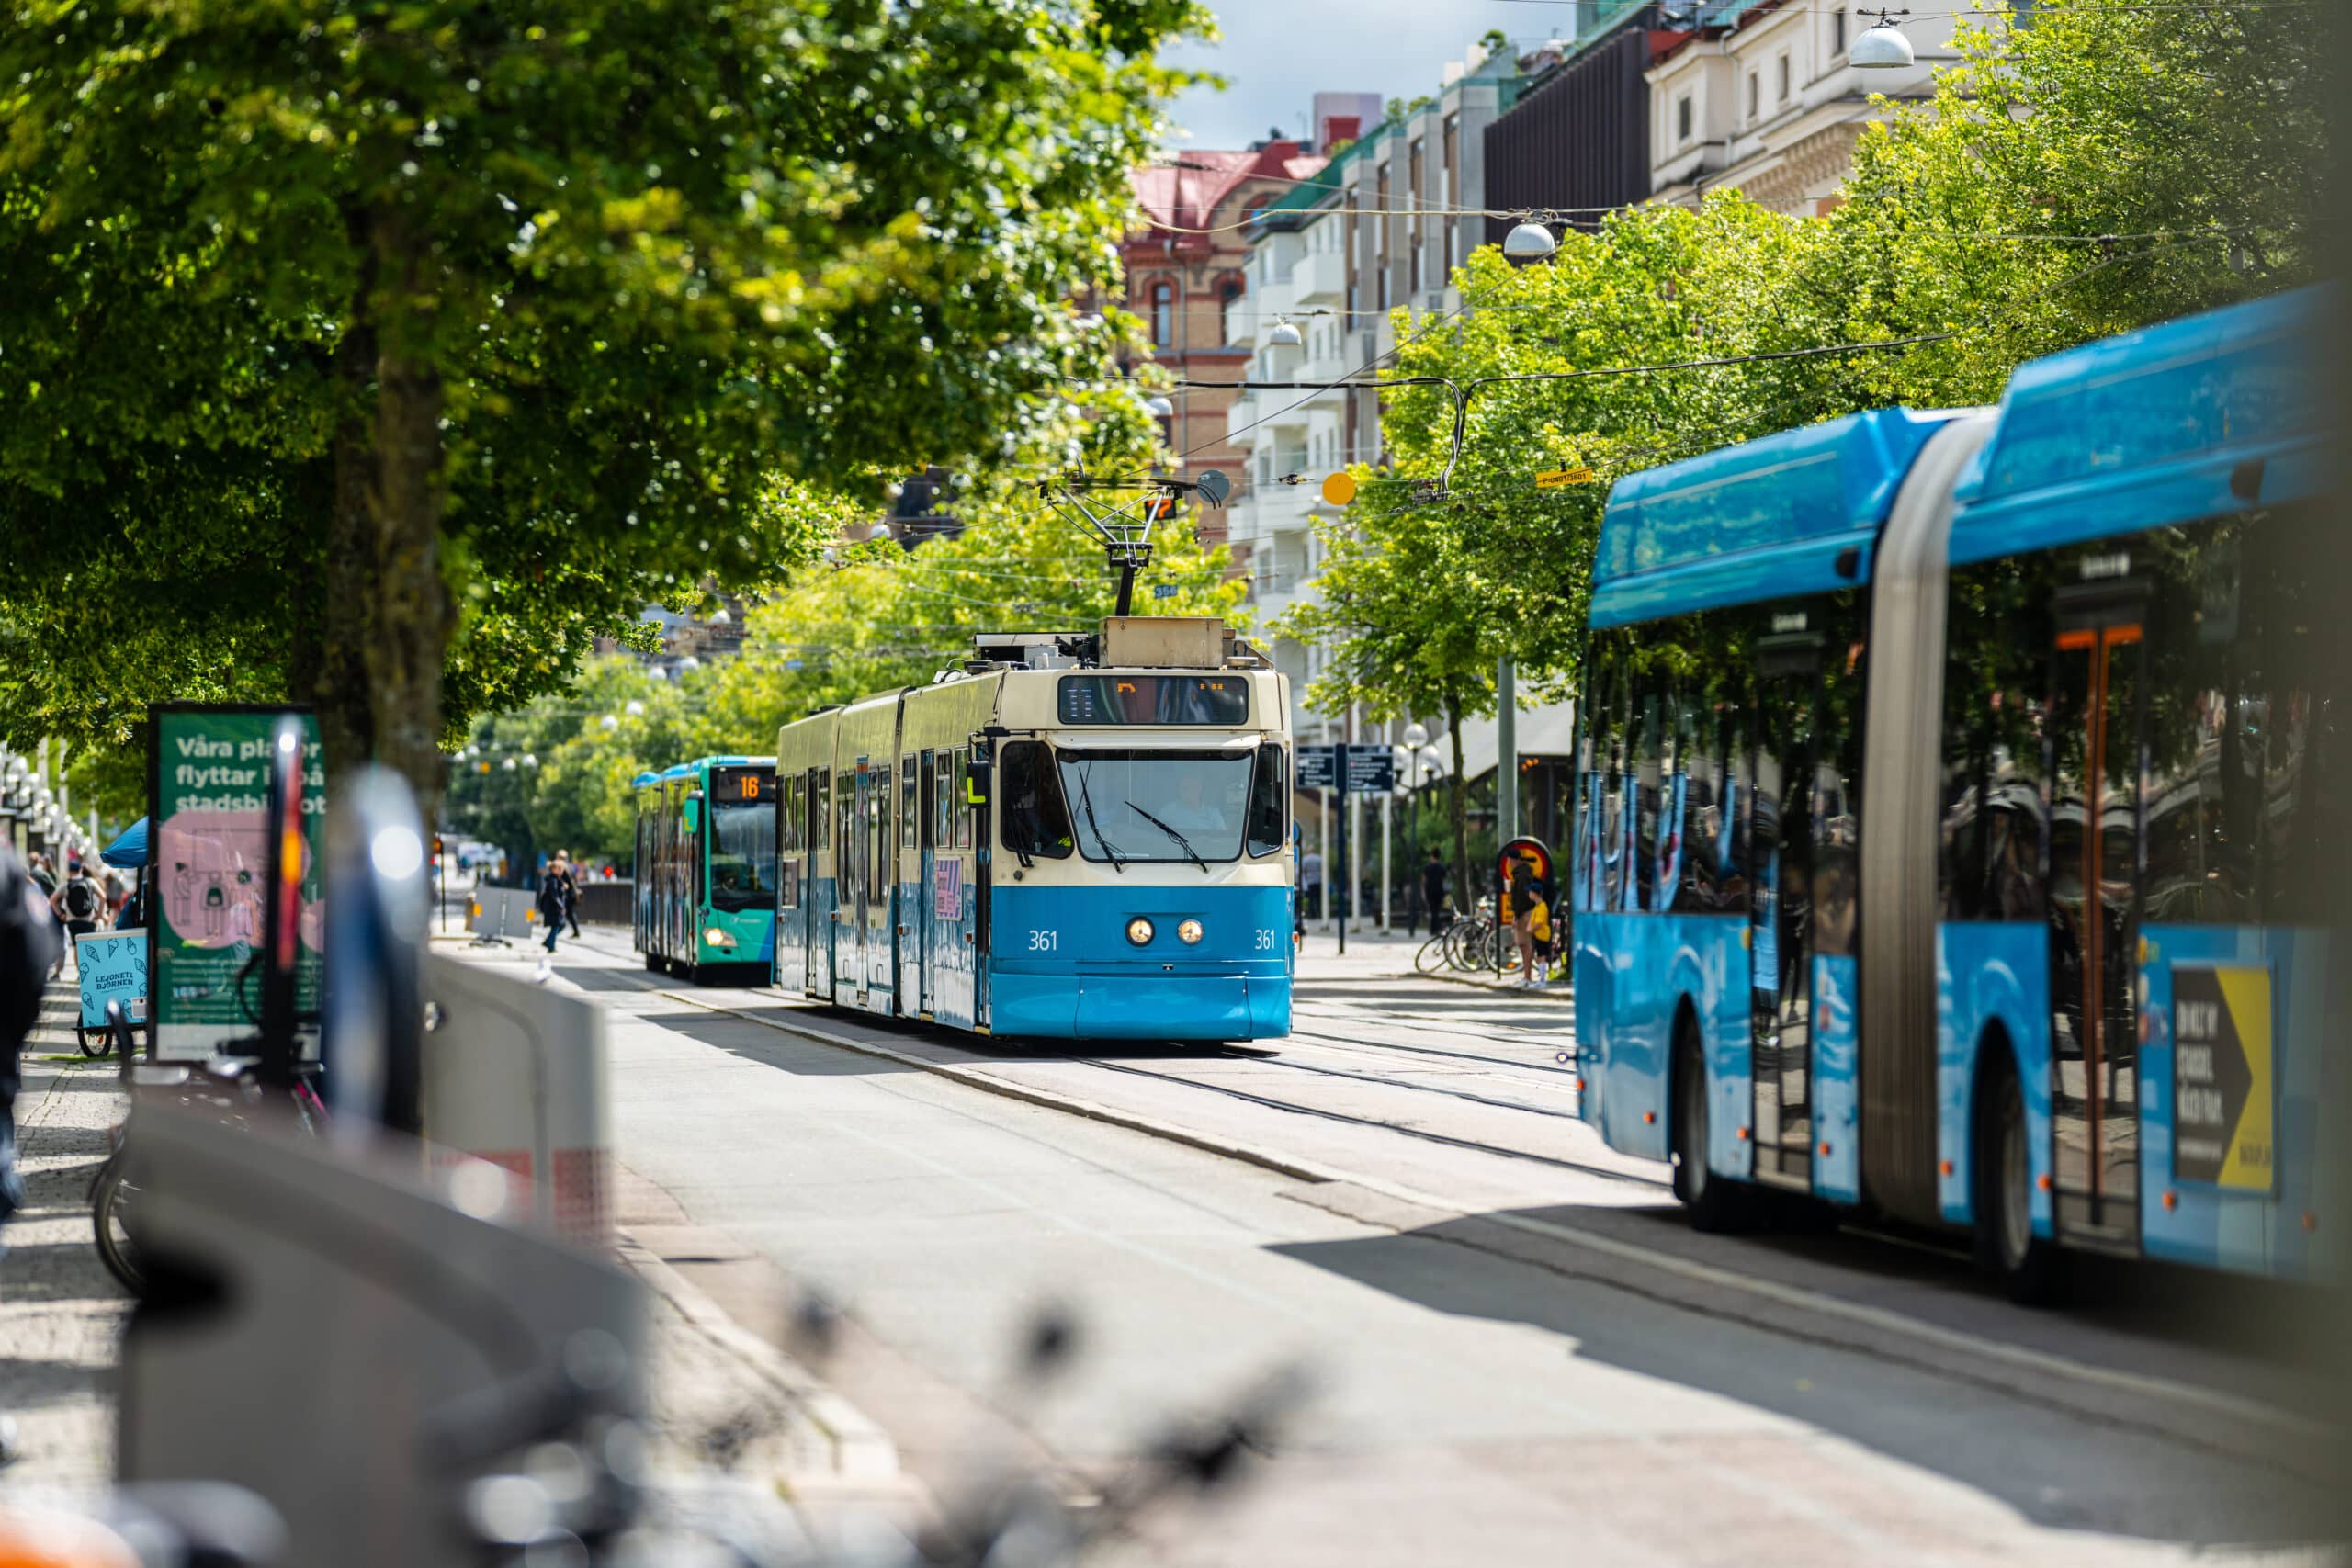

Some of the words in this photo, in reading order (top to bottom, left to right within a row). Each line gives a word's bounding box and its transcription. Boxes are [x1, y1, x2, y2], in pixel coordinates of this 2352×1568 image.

[175, 734, 233, 758] Våra
[175, 764, 257, 789] flyttar
[741, 776, 760, 798] 16
[1028, 930, 1057, 951] 361
[1255, 929, 1275, 950] 361
